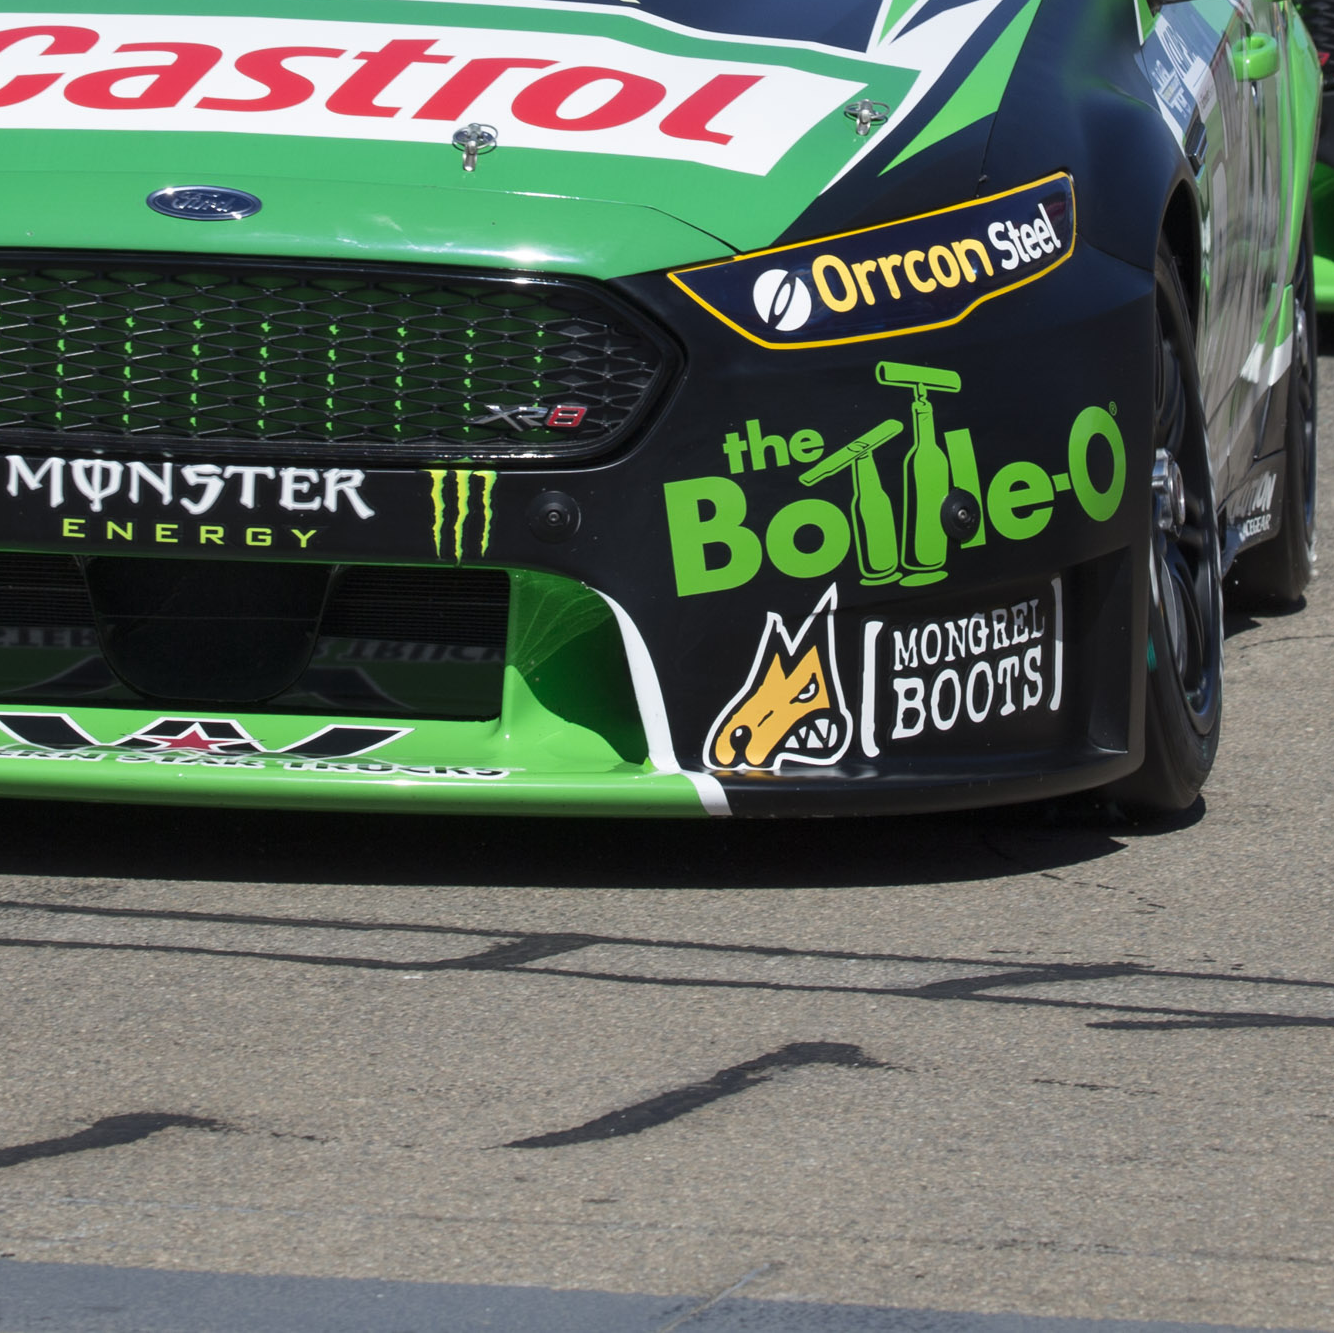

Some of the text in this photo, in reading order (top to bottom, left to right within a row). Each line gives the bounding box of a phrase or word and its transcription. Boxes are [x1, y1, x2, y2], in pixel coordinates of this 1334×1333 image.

[810, 203, 1063, 314] Orrcon Steel
[465, 404, 588, 432] XR8
[723, 419, 825, 473] the
[5, 454, 375, 519] MONSTER
[62, 517, 319, 549] ENERGY
[892, 598, 1046, 670] MONGREL
[892, 653, 1044, 741] BOOTS
